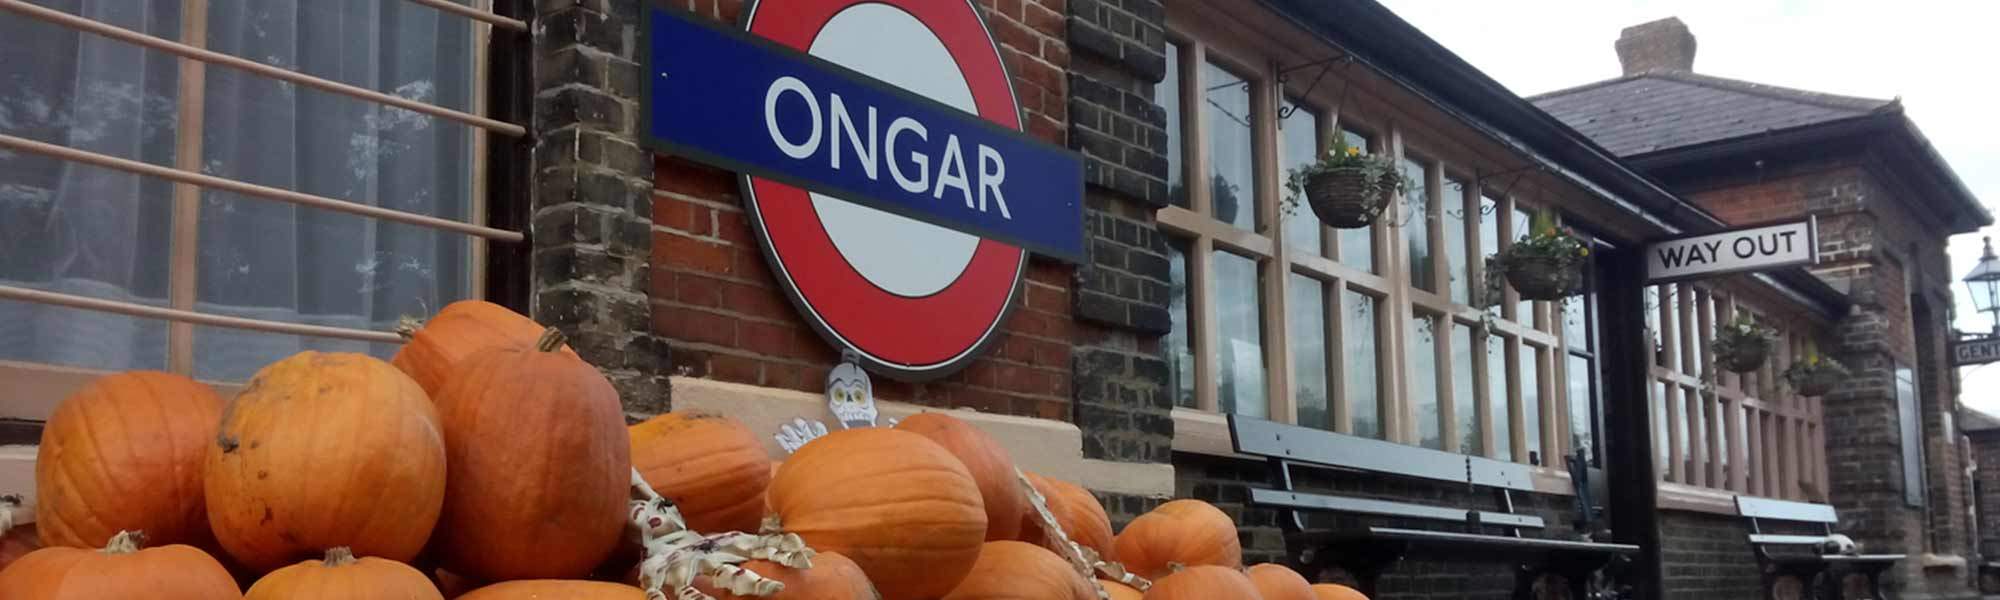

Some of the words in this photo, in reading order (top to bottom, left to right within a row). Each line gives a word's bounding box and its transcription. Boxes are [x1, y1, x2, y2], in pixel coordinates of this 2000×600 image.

[765, 76, 1011, 219] ONGAR
[1659, 240, 1722, 269] WAY
[1733, 231, 1797, 259] OUT
